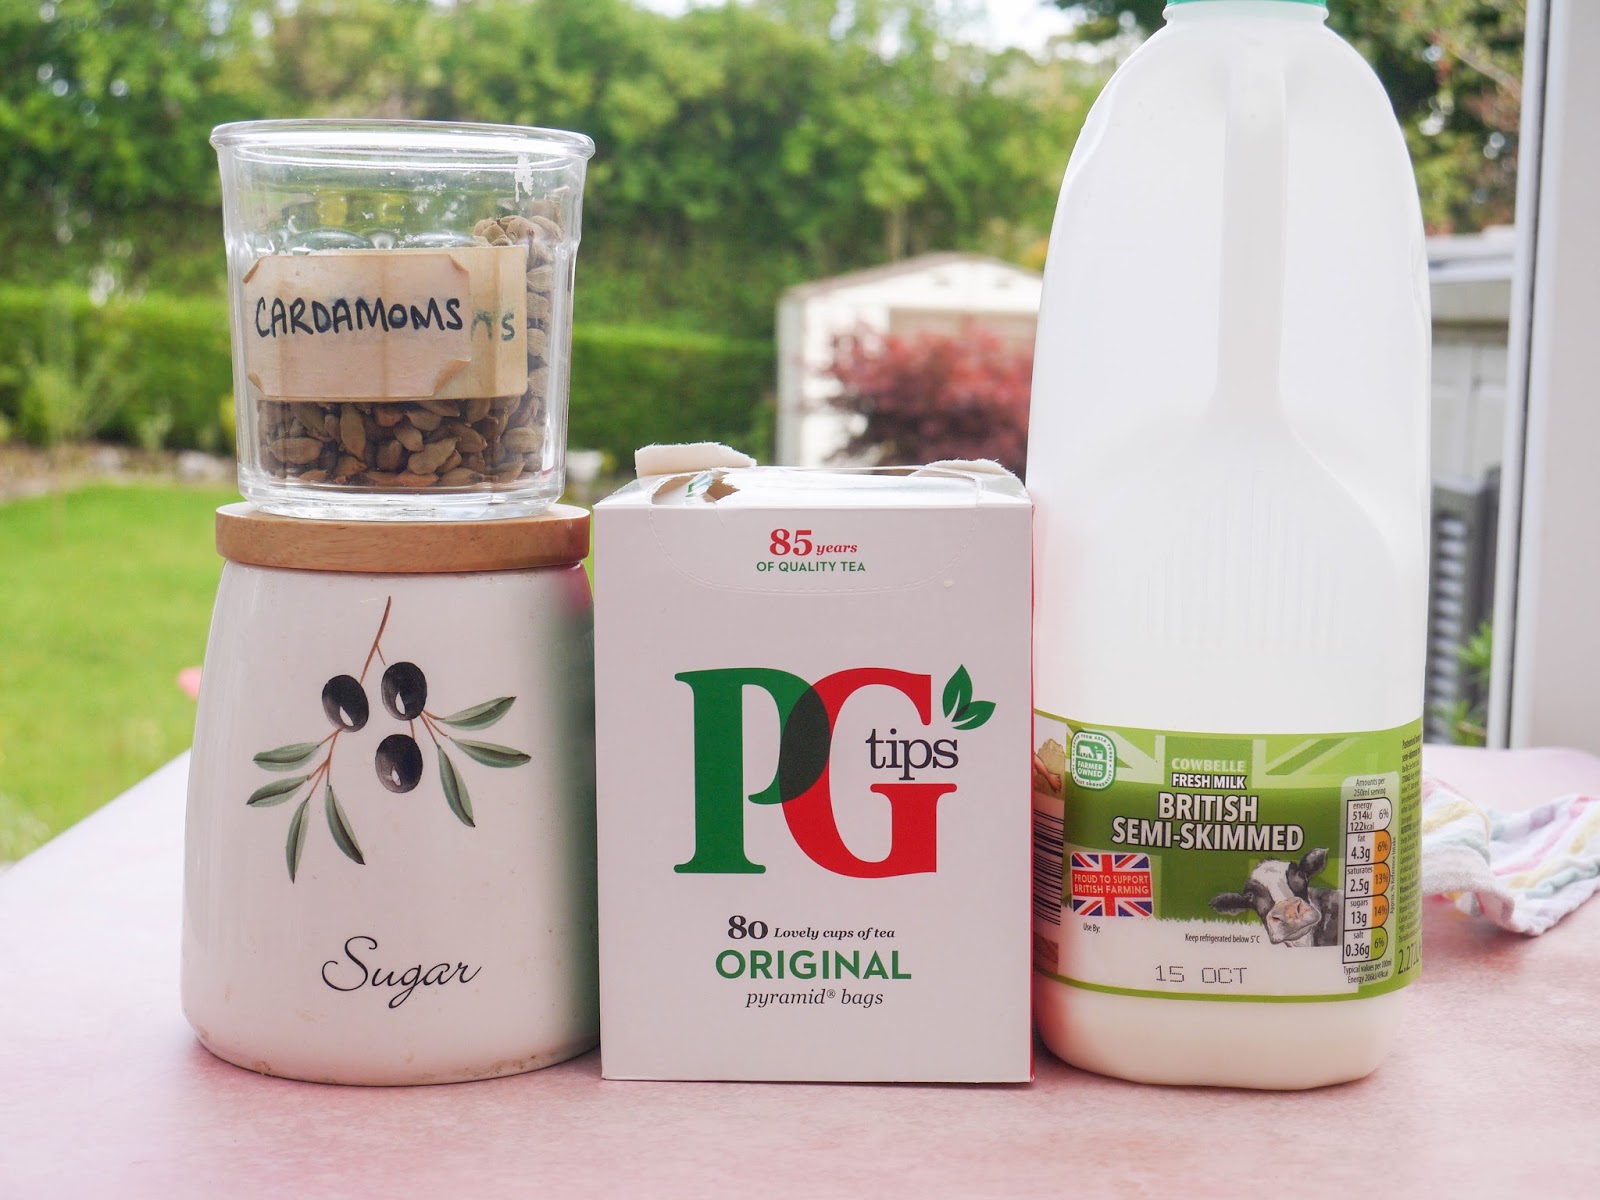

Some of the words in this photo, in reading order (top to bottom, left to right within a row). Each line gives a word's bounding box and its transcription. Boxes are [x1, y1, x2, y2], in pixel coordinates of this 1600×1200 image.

[255, 296, 463, 338] CARDAMOMS
[769, 528, 813, 556] 85
[816, 541, 858, 556] years
[756, 561, 775, 572] OF
[778, 561, 837, 573] QUALITY
[840, 561, 866, 572] TEA
[865, 728, 960, 781] tips
[1077, 760, 1103, 771] FARMER
[1171, 757, 1245, 773] COWBELLE
[673, 667, 958, 878] PG
[1077, 767, 1103, 778] OWNED
[1172, 772, 1211, 789] FRESH
[1213, 774, 1247, 790] MILK
[1354, 788, 1369, 797] 250ml
[1371, 788, 1386, 796] serving
[1158, 792, 1259, 823] BRITISH
[1353, 802, 1373, 810] energy
[1353, 810, 1372, 821] 514kJ
[1379, 808, 1389, 820] 6%
[1350, 821, 1374, 832] 122kcal
[1111, 816, 1305, 851] SEMI-SKIMMED
[1378, 840, 1388, 852] 6%
[1351, 846, 1370, 862] 4.3g
[1347, 866, 1373, 875] saturates
[1074, 873, 1098, 884] PROUD
[1100, 874, 1112, 884] TO
[1113, 875, 1149, 885] SUPPORT
[1375, 872, 1389, 885] 13%
[1074, 883, 1104, 894] BRITISH
[1106, 885, 1149, 895] FARMING
[1350, 878, 1370, 895] 2.5g
[1350, 899, 1369, 908] sugars
[1374, 904, 1387, 917] 14%
[1351, 910, 1367, 927] 13g
[727, 914, 769, 940] 80
[773, 926, 820, 941] Lovely
[823, 928, 854, 941] cups
[857, 926, 874, 941] of
[874, 927, 896, 938] tea
[1083, 922, 1093, 932] Use
[1093, 923, 1101, 934] By:
[1185, 933, 1199, 943] Keep
[1199, 934, 1232, 944] refrigerated
[1232, 935, 1250, 943] below
[1353, 931, 1364, 940] salt
[1374, 937, 1385, 949] 6%
[1345, 942, 1370, 959] 0.36g
[715, 949, 912, 980] ORIGINAL
[1344, 964, 1360, 975] Typical
[1361, 963, 1374, 972] values
[1382, 958, 1392, 968] 100ml
[321, 935, 483, 1009] Sugar
[1155, 964, 1185, 983] 15
[1201, 967, 1248, 984] OCT
[1348, 975, 1364, 985] Energy
[841, 988, 884, 1009] bags
